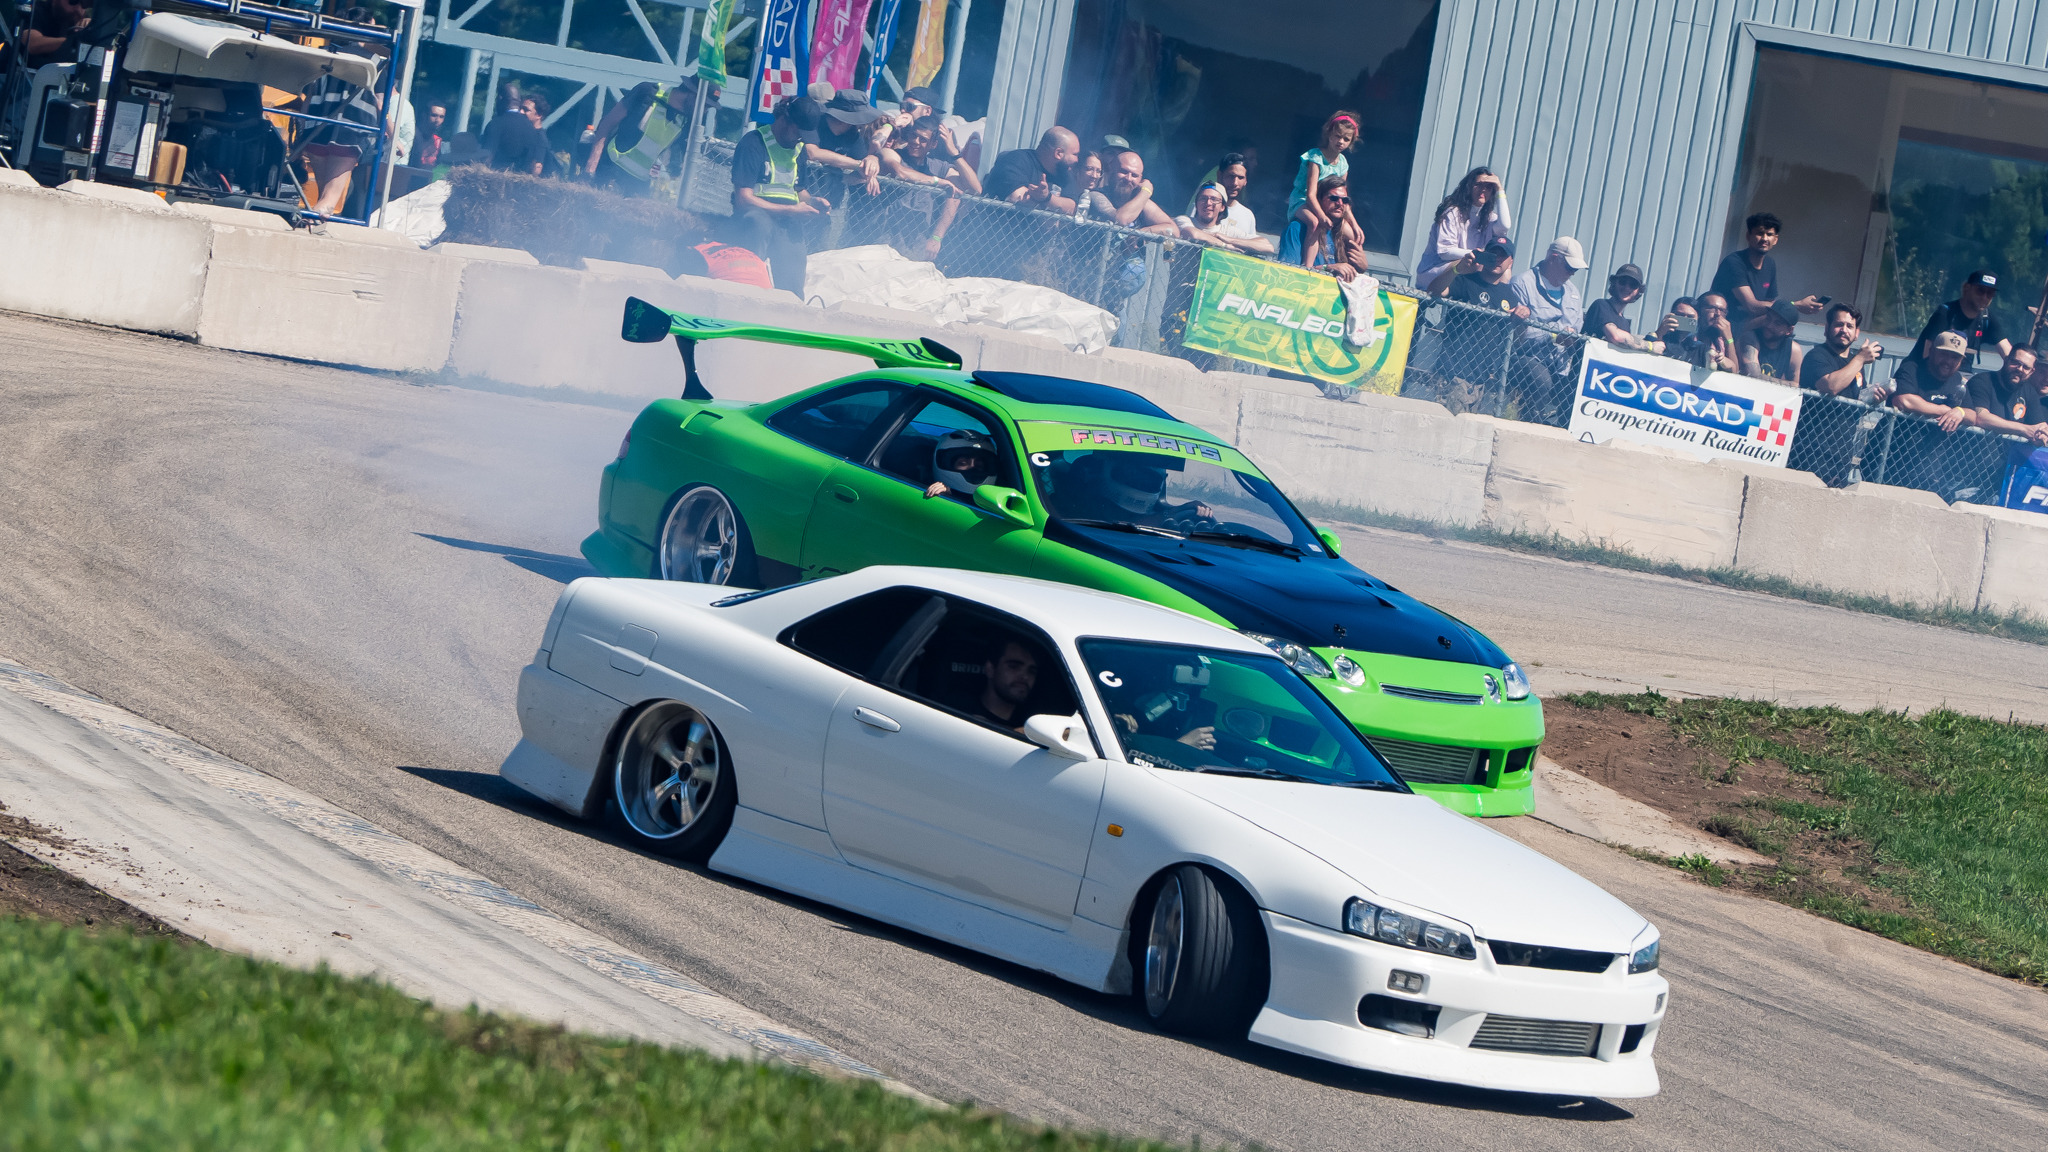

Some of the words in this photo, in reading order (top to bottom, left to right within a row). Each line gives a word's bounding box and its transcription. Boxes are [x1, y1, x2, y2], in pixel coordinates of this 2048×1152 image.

[1217, 293, 1300, 329] FINAL
[1590, 368, 1745, 426] KOYORAD
[1071, 429, 1222, 461] FATCATS
[1580, 400, 1697, 443] Competition
[1701, 429, 1781, 462] Radiator
[1031, 452, 1051, 467] C
[1099, 671, 1123, 688] C
